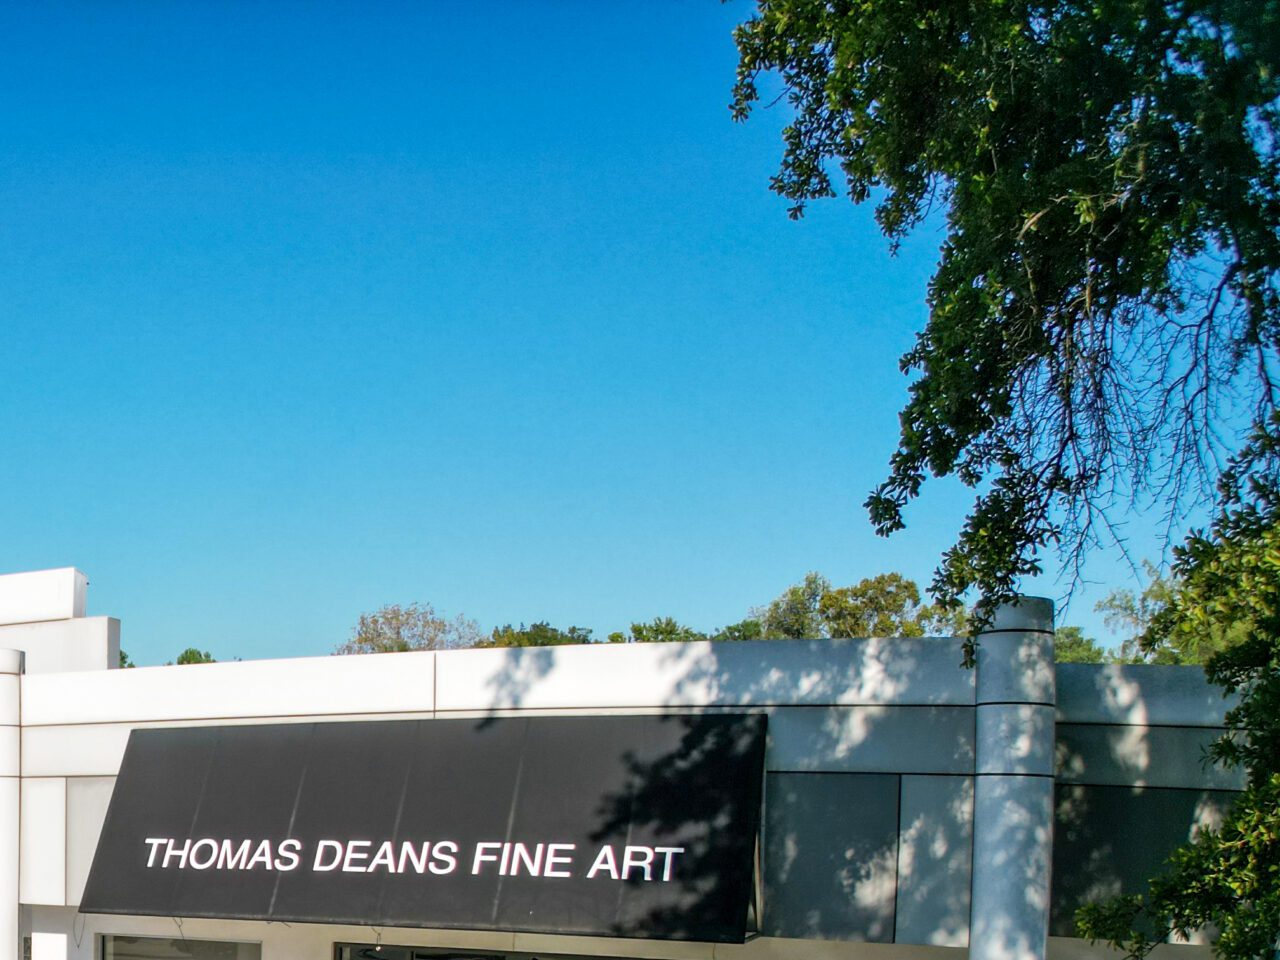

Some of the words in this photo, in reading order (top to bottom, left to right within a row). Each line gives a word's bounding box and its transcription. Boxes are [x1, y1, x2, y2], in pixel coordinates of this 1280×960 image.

[144, 837, 302, 872] THOMAS
[312, 839, 459, 876] DEANS
[471, 841, 576, 878] FINE
[586, 844, 685, 882] ART
